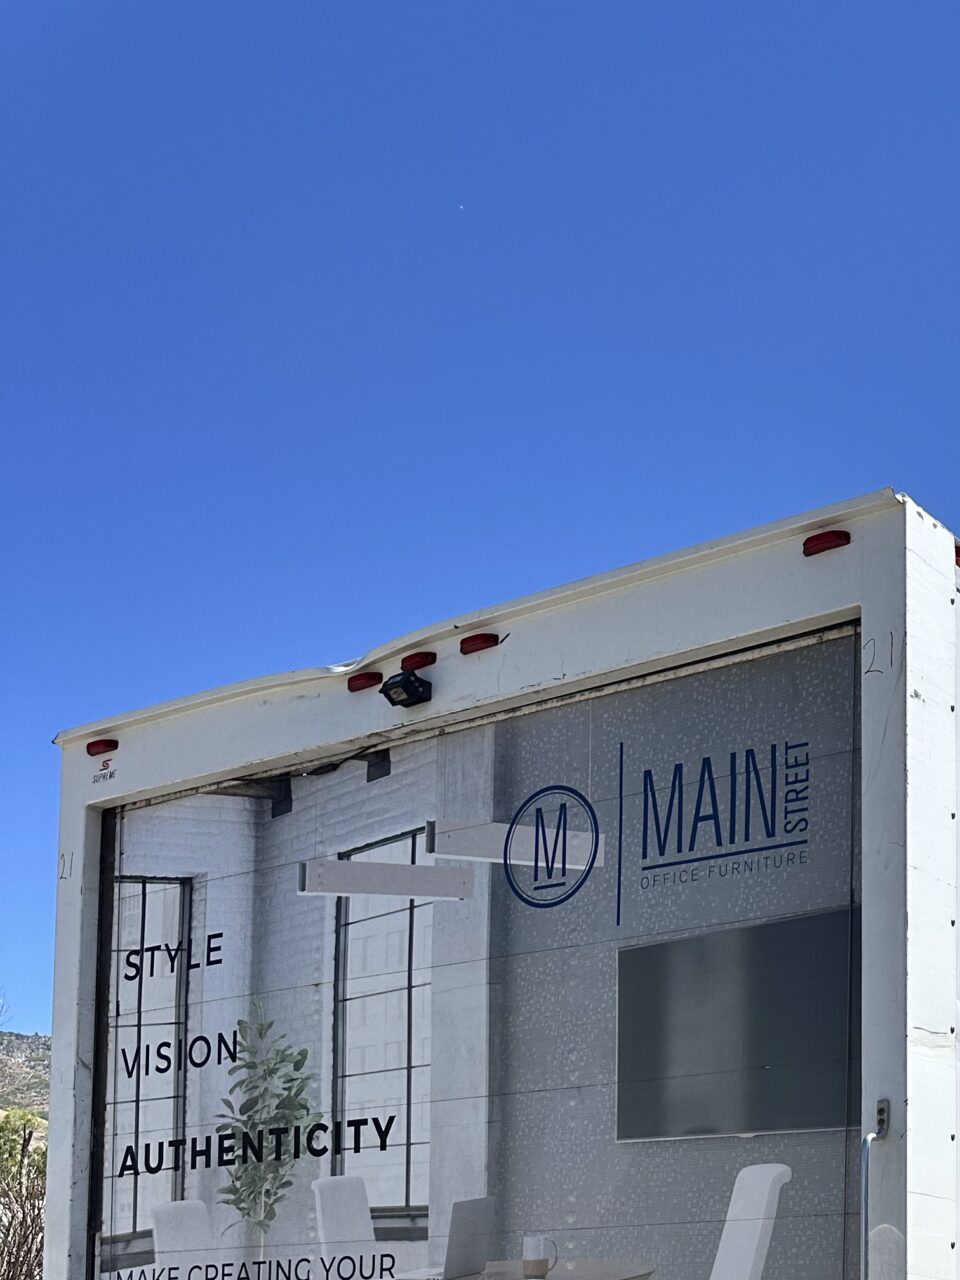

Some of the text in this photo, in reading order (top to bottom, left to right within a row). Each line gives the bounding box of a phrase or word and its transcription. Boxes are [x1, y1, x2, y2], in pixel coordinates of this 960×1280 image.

[641, 743, 777, 860] MAIN
[784, 740, 809, 834] STREET
[640, 850, 809, 890] OFFICE FURNITURE
[123, 932, 224, 981] STYLE
[121, 1030, 238, 1079] VISION
[118, 1115, 396, 1178] AUTHENTICITY
